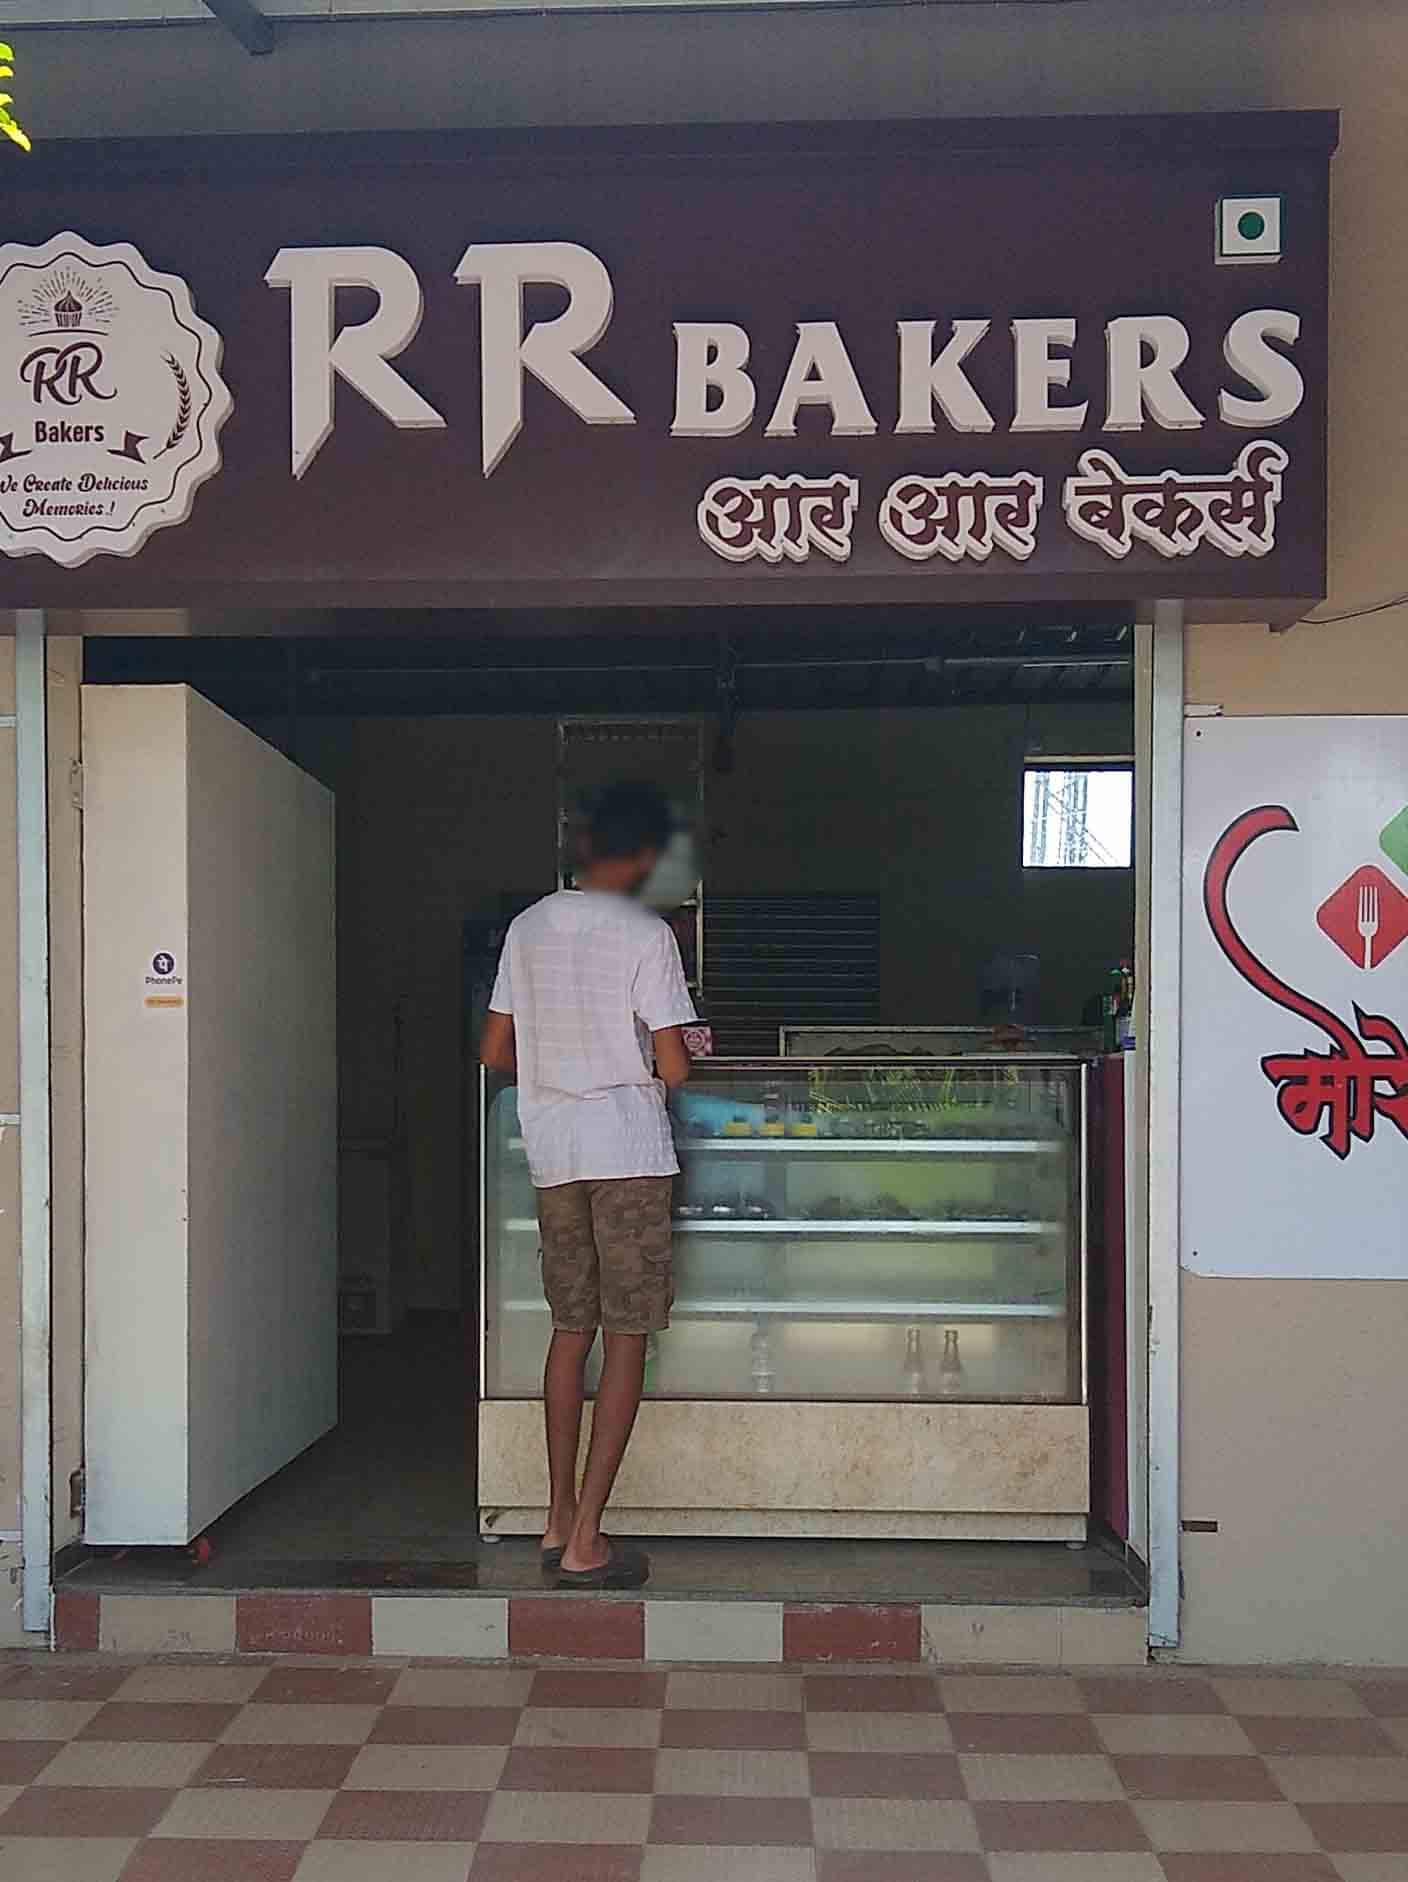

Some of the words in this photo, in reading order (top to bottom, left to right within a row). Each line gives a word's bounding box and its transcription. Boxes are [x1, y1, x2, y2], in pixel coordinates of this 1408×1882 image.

[20, 341, 118, 405] RR
[669, 309, 1304, 437] BAKERS
[35, 420, 105, 443] Bakers
[23, 473, 73, 493] Create
[78, 472, 149, 492] Delicious
[697, 473, 860, 563] आर
[878, 472, 1044, 562] आर
[1062, 439, 1290, 559] बेकर्स
